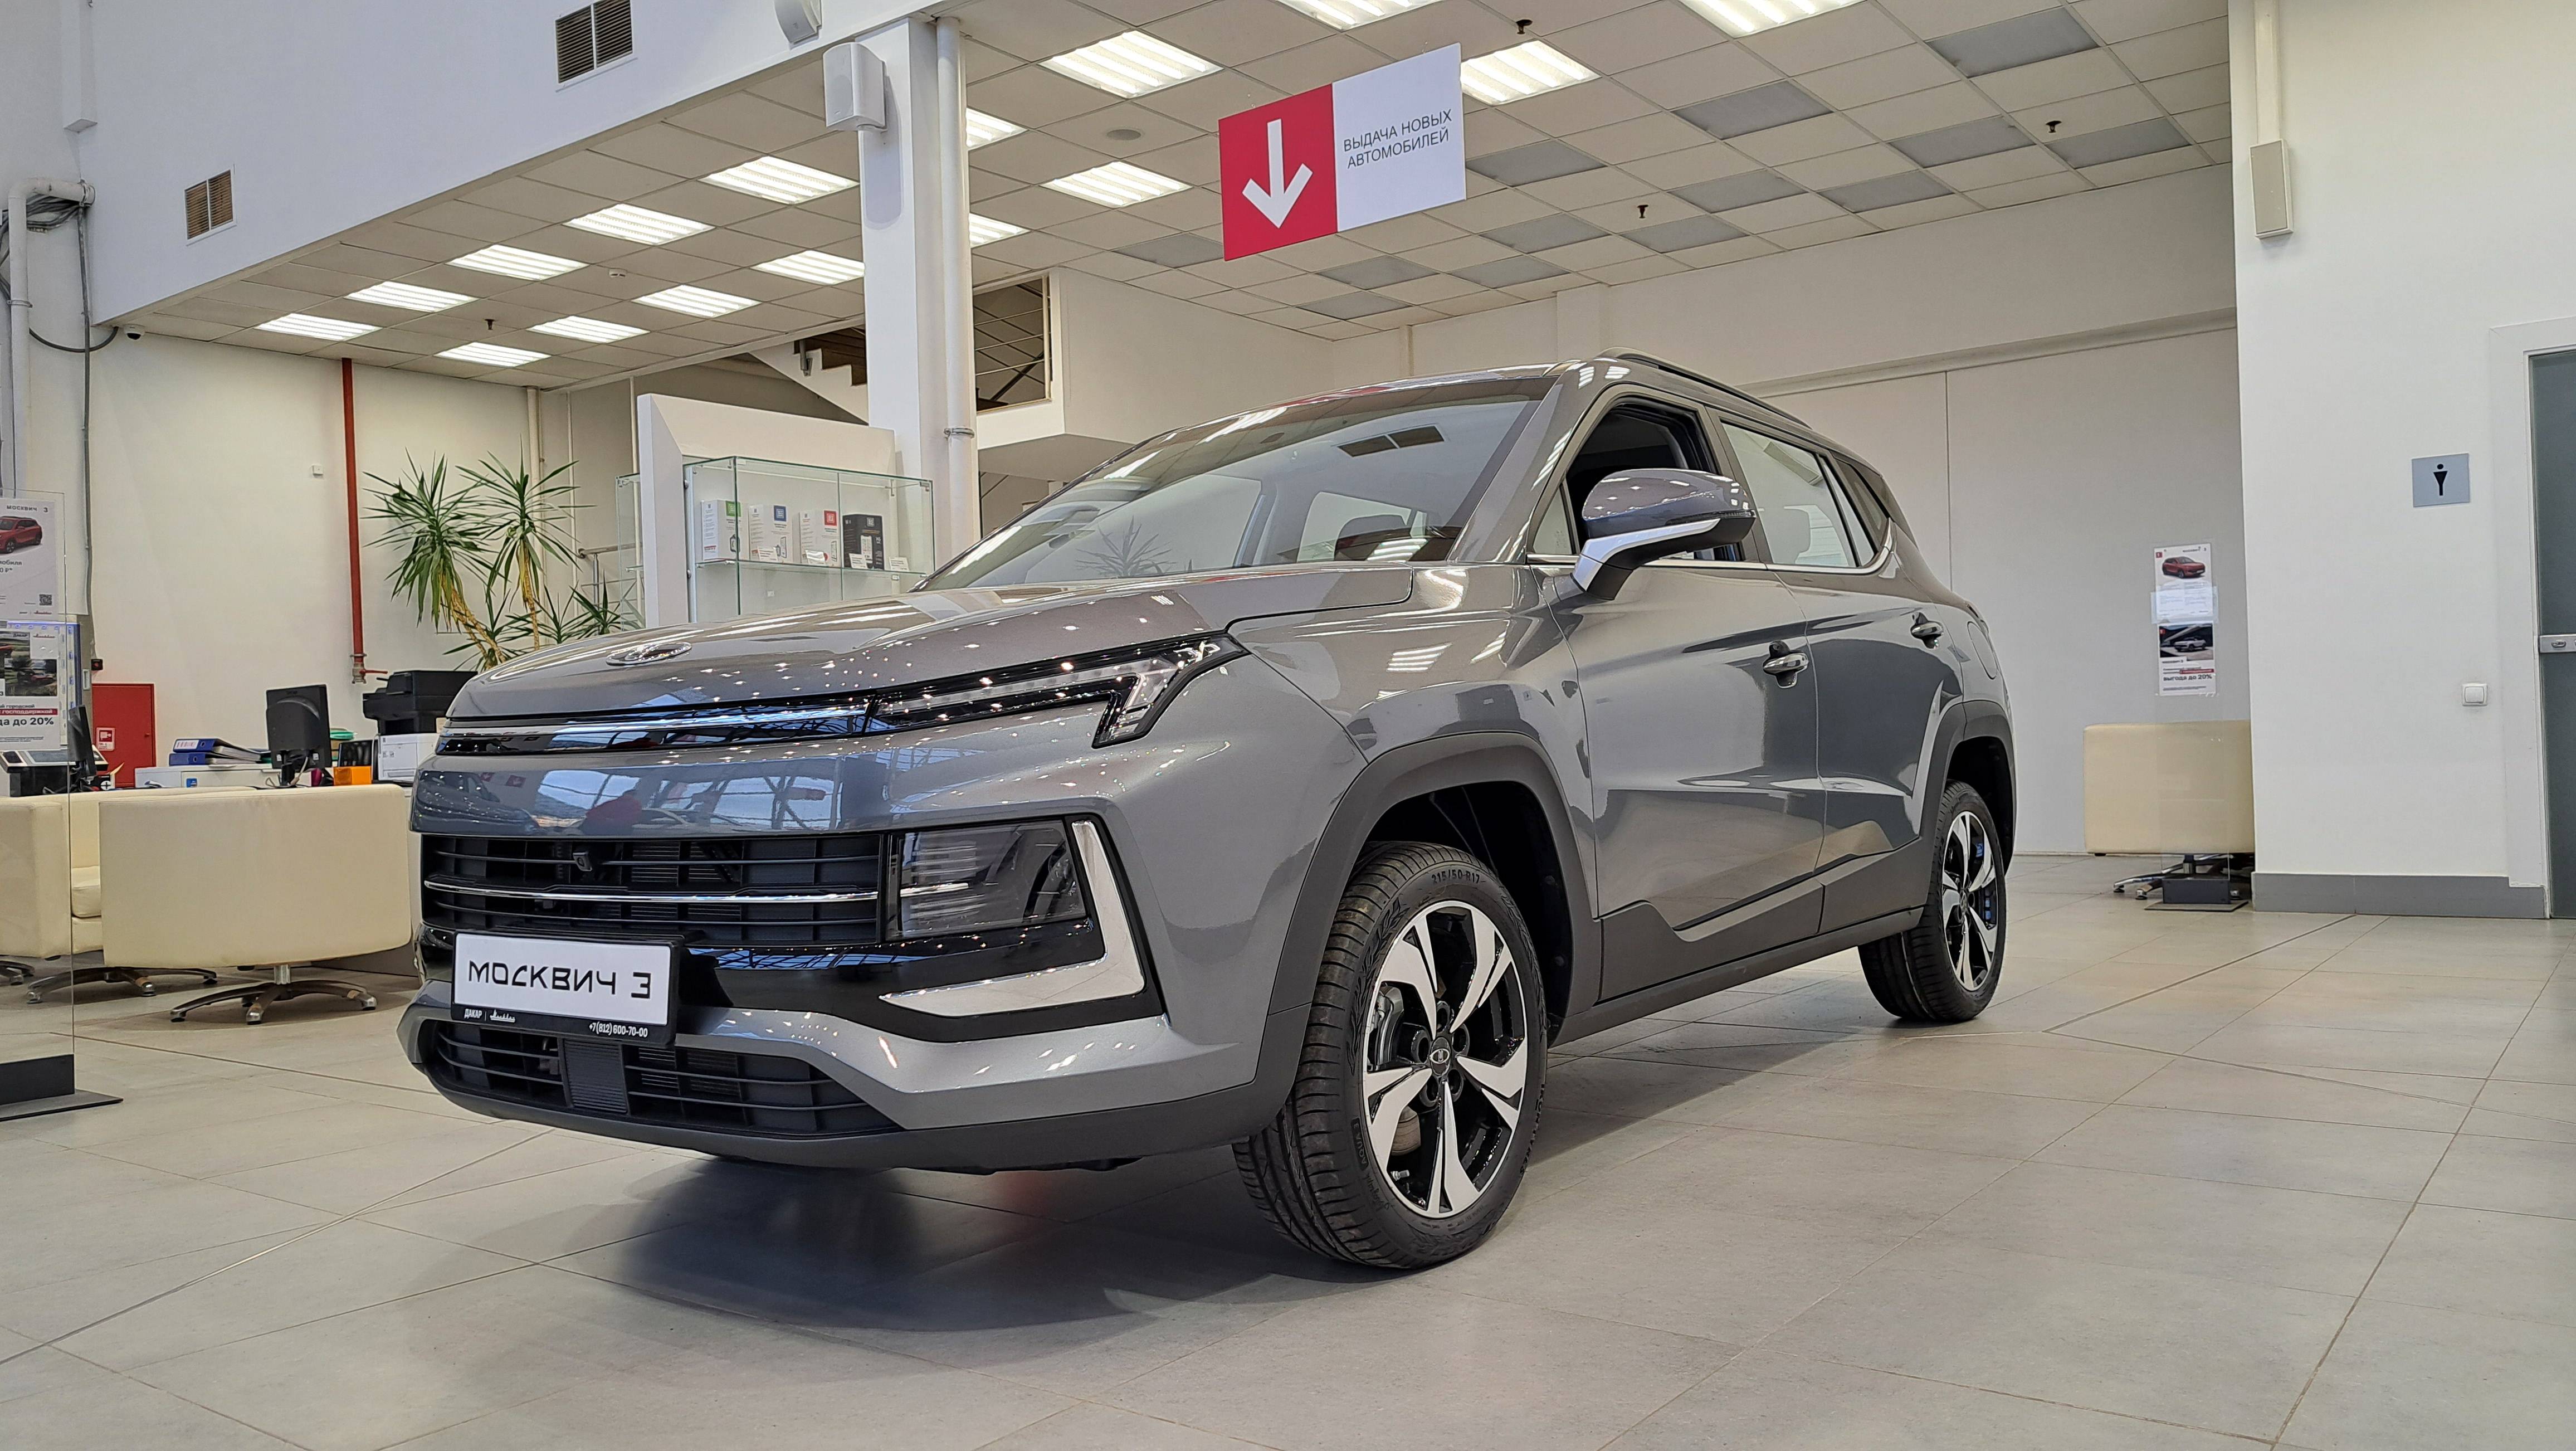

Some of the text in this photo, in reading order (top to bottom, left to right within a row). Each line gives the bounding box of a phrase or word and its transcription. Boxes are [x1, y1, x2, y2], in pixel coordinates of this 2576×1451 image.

[1344, 109, 1452, 152] ВЫДАЧА НОВЫХ
[1347, 126, 1448, 169] АВТОМОБИЛЕЙ
[469, 960, 651, 999] МОСКВИЧ 3
[464, 1008, 482, 1019] ДАКАР
[1355, 1133, 1367, 1164] AQUA
